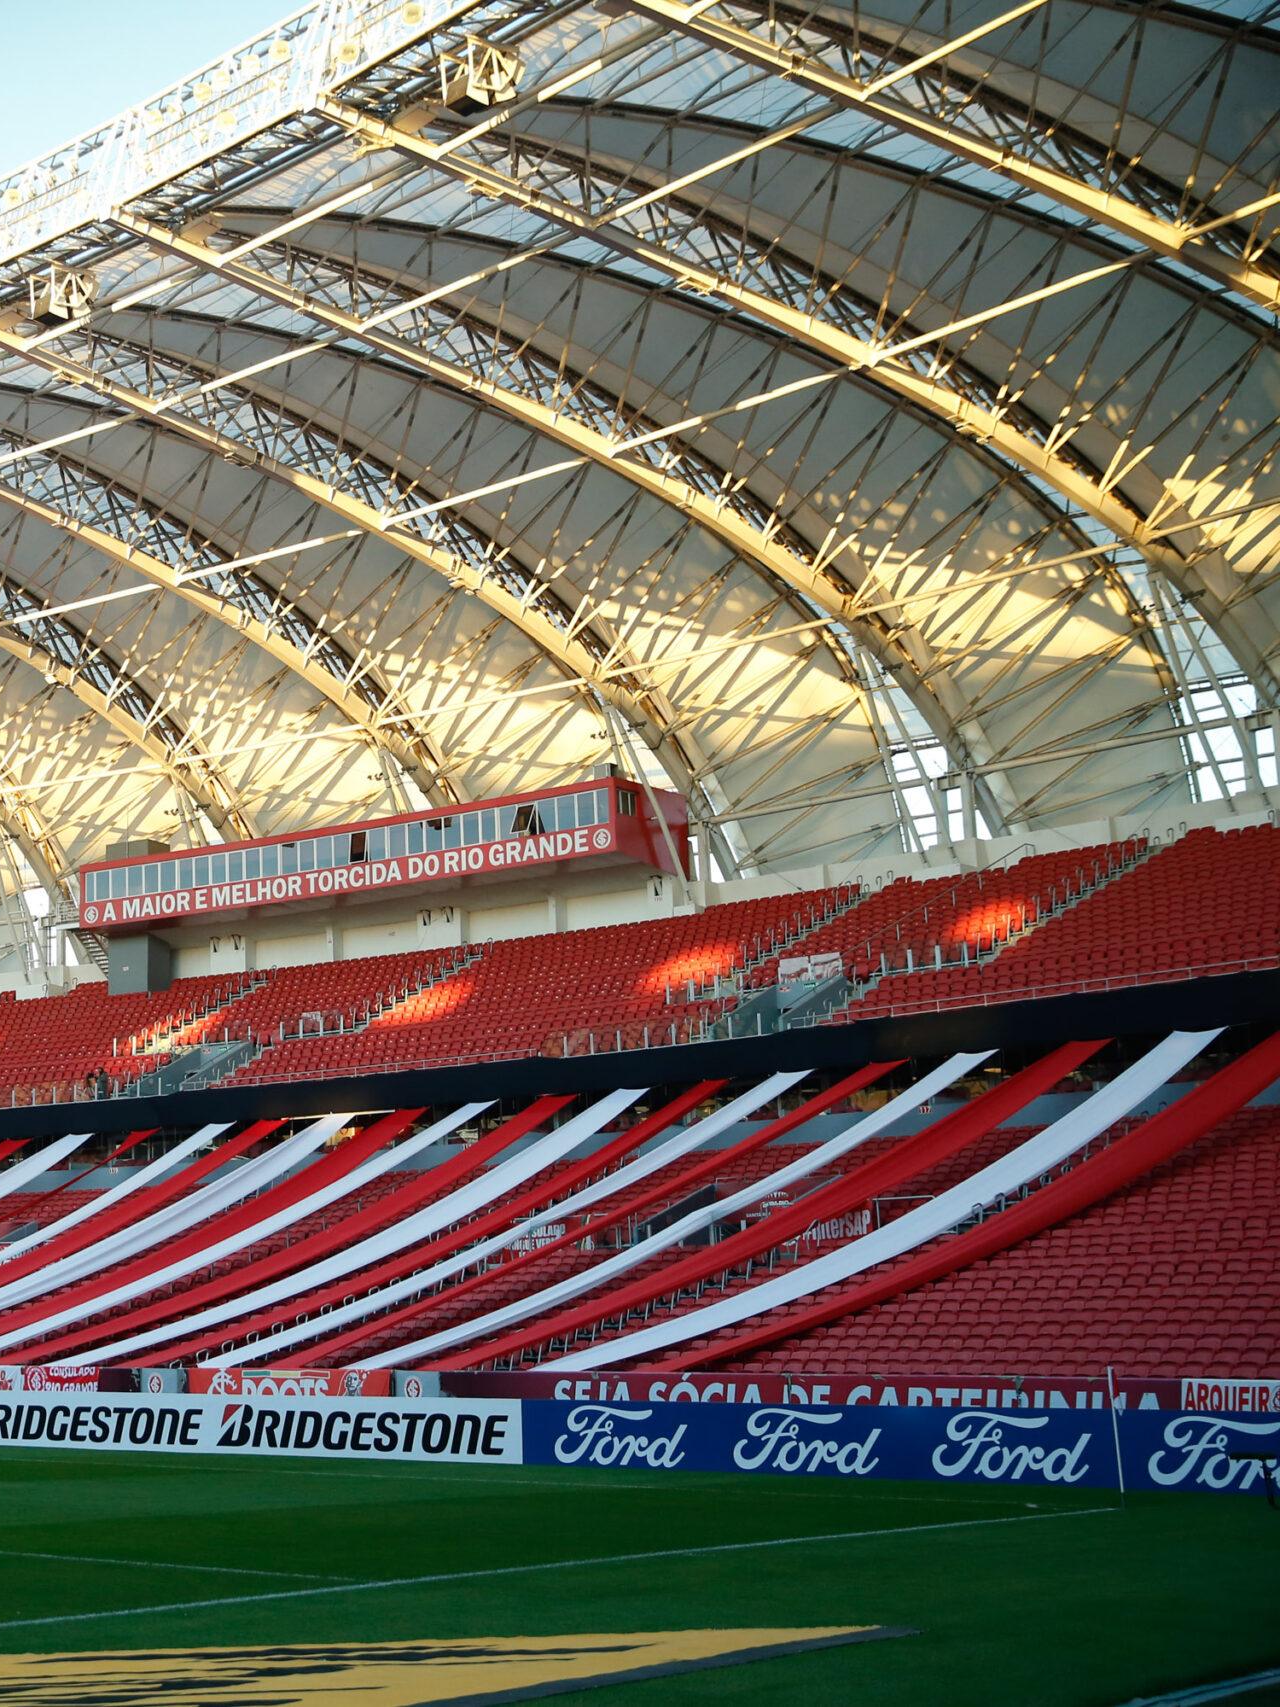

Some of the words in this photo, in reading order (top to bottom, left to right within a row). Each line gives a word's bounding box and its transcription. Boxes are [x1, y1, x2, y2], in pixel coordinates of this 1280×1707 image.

[102, 903, 117, 922] A
[122, 892, 190, 920] MAIOR
[195, 889, 208, 909] E
[212, 875, 302, 907] MELHOR
[306, 860, 402, 892] TORCIDA
[408, 854, 439, 879] DO
[444, 848, 484, 874] RIO
[488, 830, 589, 866] GRANDE
[48, 1366, 96, 1378] CONSULADO
[216, 1404, 508, 1456] BRIDGESTONE
[554, 1404, 688, 1468] Ford
[733, 1407, 882, 1475] Ford
[931, 1411, 1092, 1482] Ford
[1148, 1416, 1280, 1489] For
